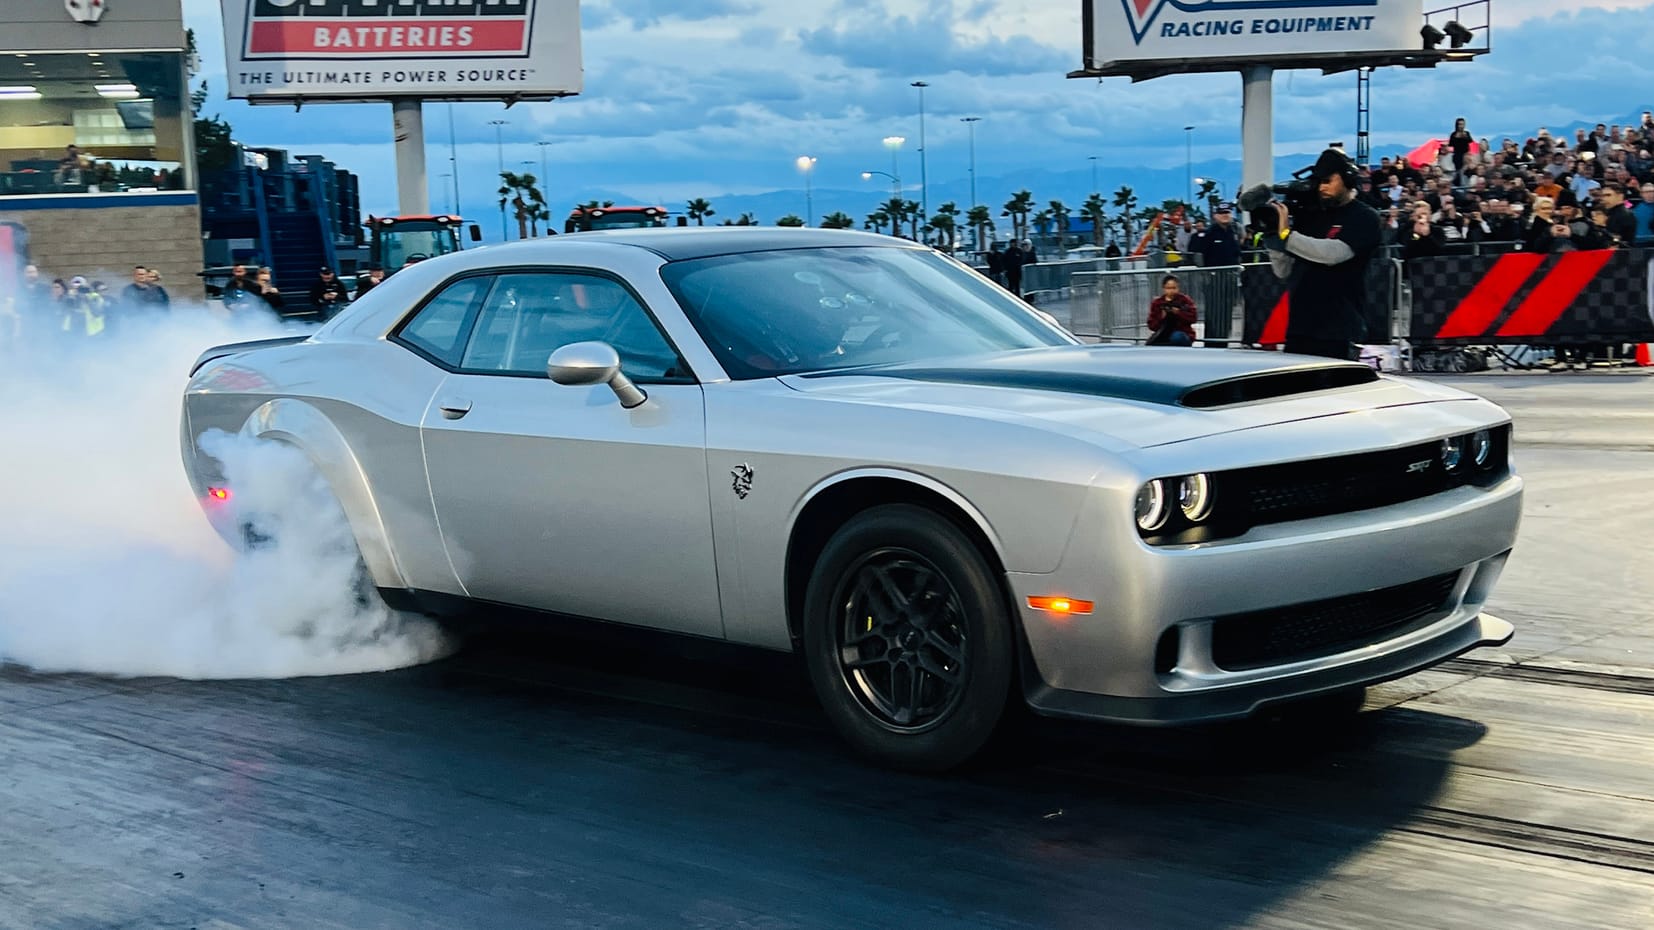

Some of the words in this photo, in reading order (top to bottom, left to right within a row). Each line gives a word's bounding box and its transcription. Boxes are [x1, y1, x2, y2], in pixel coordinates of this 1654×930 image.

[313, 26, 473, 47] BATTERIES
[1161, 20, 1244, 37] RACING
[1251, 16, 1375, 34] EQUIPMENT
[239, 72, 273, 84] THE
[283, 72, 371, 84] ULTIMATE
[382, 71, 447, 82] POWER
